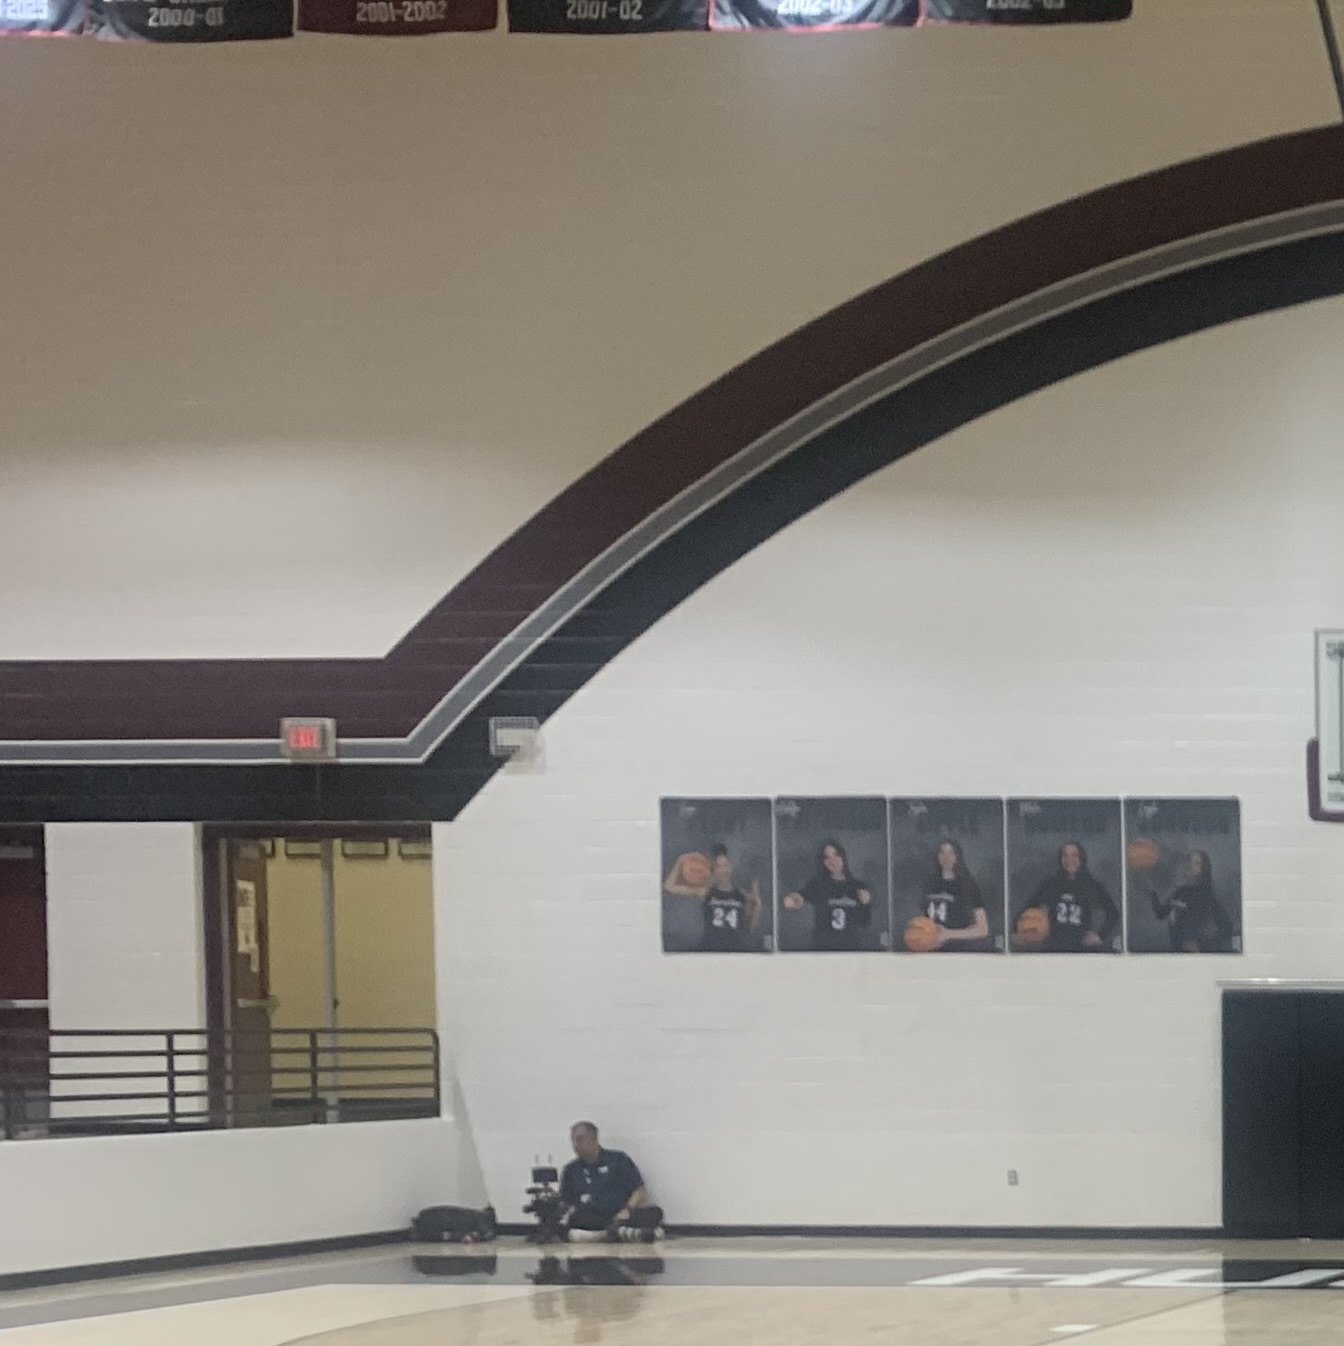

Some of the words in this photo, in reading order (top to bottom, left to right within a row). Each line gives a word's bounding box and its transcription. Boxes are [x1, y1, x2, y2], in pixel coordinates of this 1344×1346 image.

[147, 7, 225, 27] 2000-01
[356, 1, 449, 23] 2001-2002
[566, 0, 643, 20] 2001-02
[711, 907, 739, 930] 24
[831, 907, 847, 931] 3
